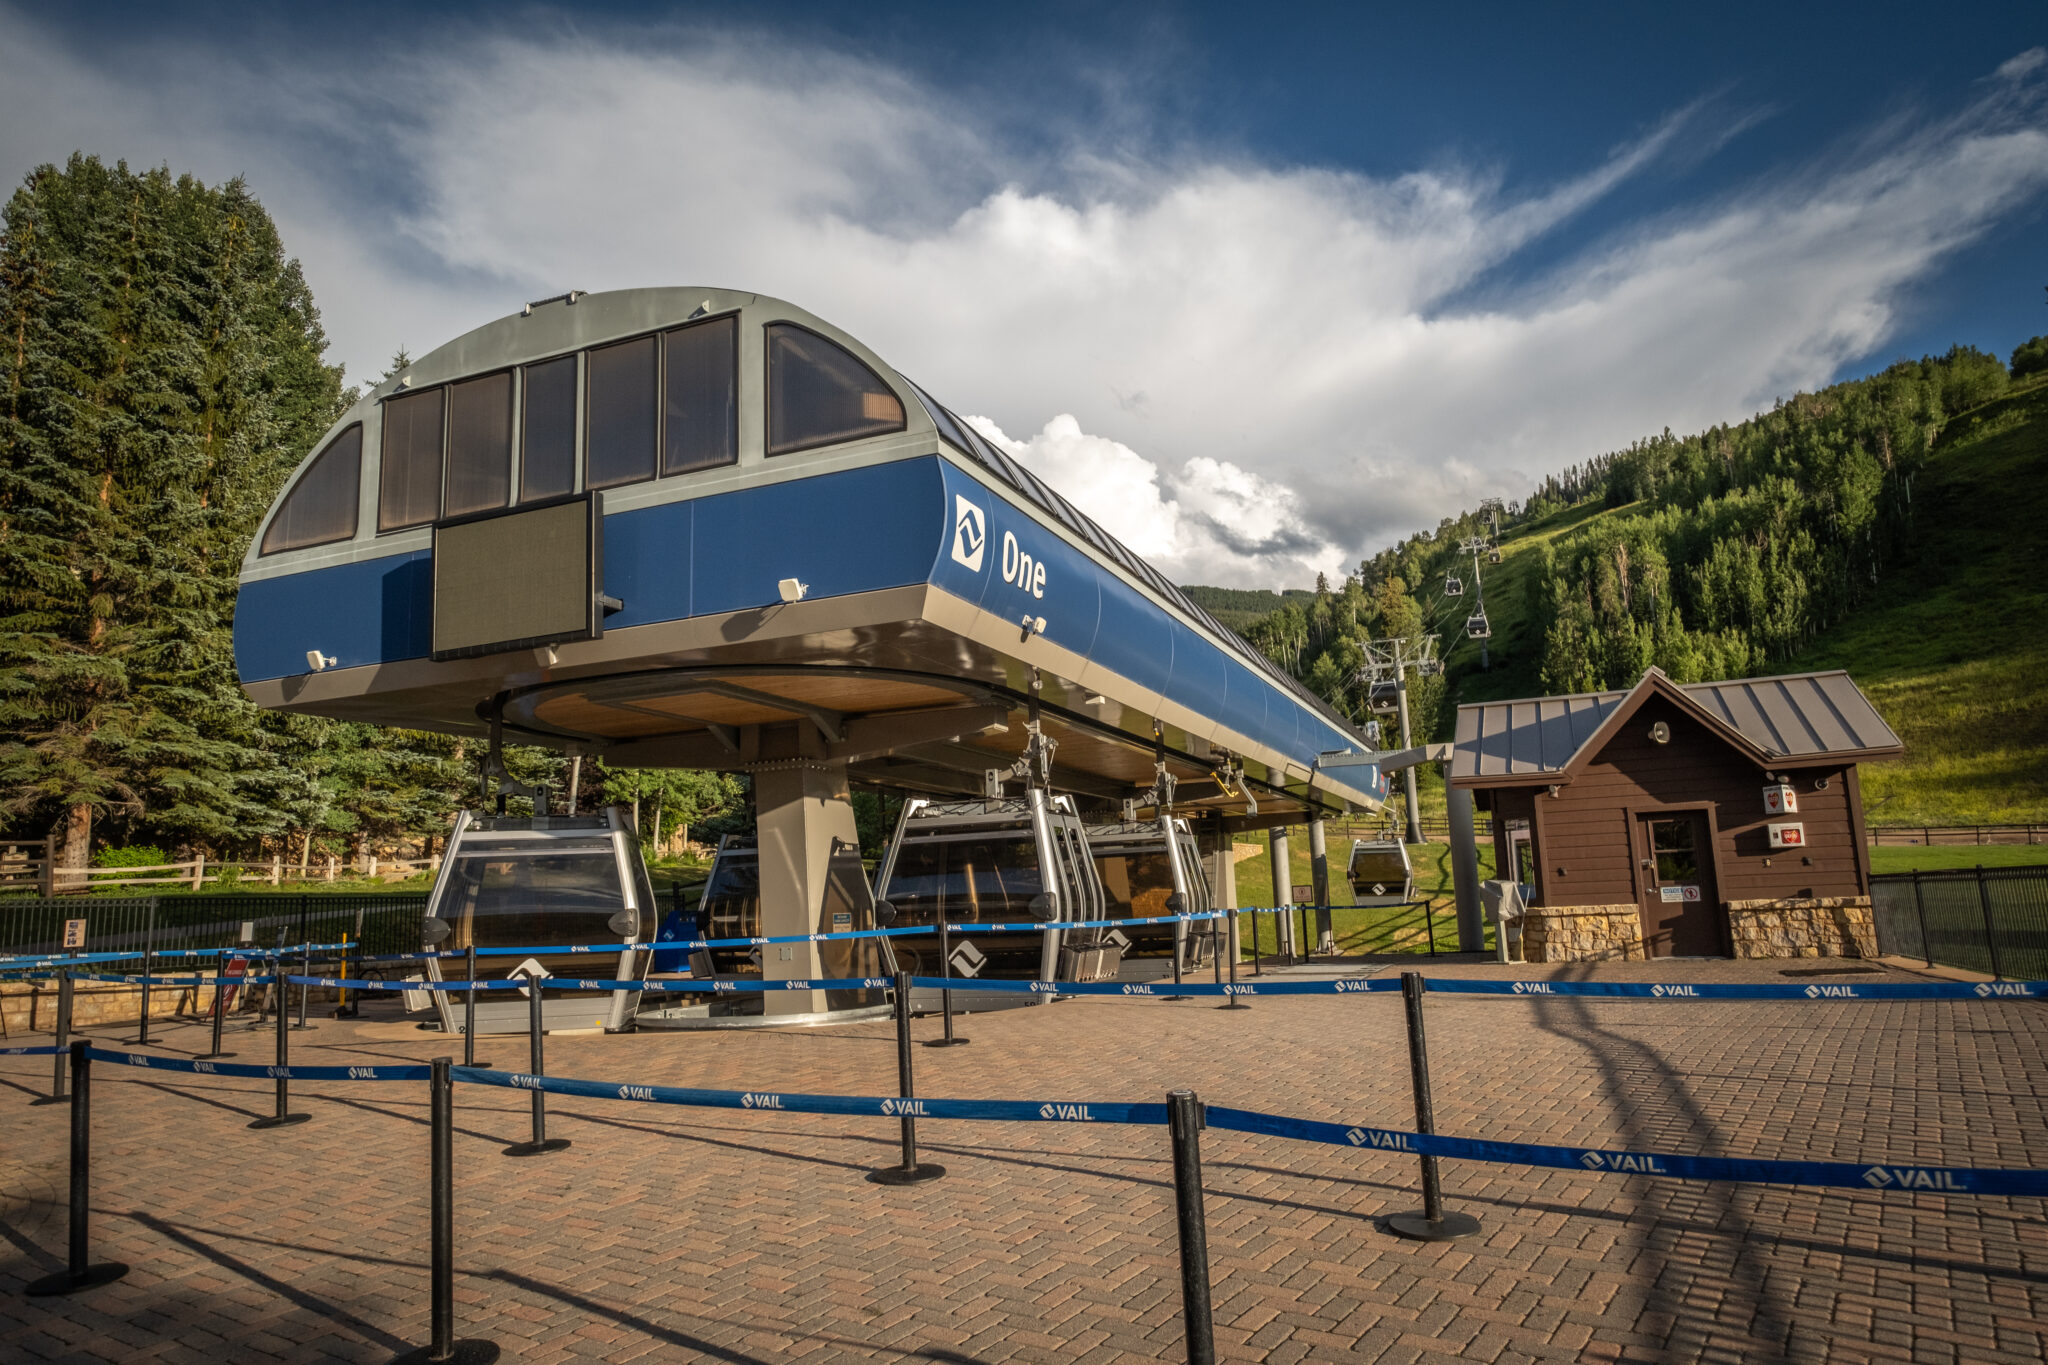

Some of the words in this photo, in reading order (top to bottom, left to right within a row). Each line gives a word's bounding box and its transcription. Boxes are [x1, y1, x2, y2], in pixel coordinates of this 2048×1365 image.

[1002, 530, 1046, 599] One
[794, 981, 811, 989] VAIL
[1039, 983, 1059, 992] VAIL
[1132, 985, 1154, 994] VAIL
[1234, 985, 1258, 995] VAIL
[1346, 981, 1371, 991] VAIL
[1524, 982, 1555, 994] VAIL
[1665, 984, 1699, 996] VAIL
[1991, 984, 2033, 996] VAIL
[1820, 986, 1858, 998] VAIL
[134, 1056, 149, 1065] VAIL
[200, 1063, 217, 1073] VAIL
[275, 1067, 292, 1077] VAIL
[357, 1068, 377, 1078] VAIL
[521, 1077, 543, 1089] VAIL
[630, 1087, 656, 1100] VAIL
[755, 1094, 784, 1108] VAIL
[896, 1101, 930, 1115] VAIL
[1057, 1105, 1095, 1120] VAIL
[1367, 1131, 1417, 1151] VAIL
[1606, 1154, 1667, 1173] VAIL
[1894, 1169, 1968, 1190] VAIL
